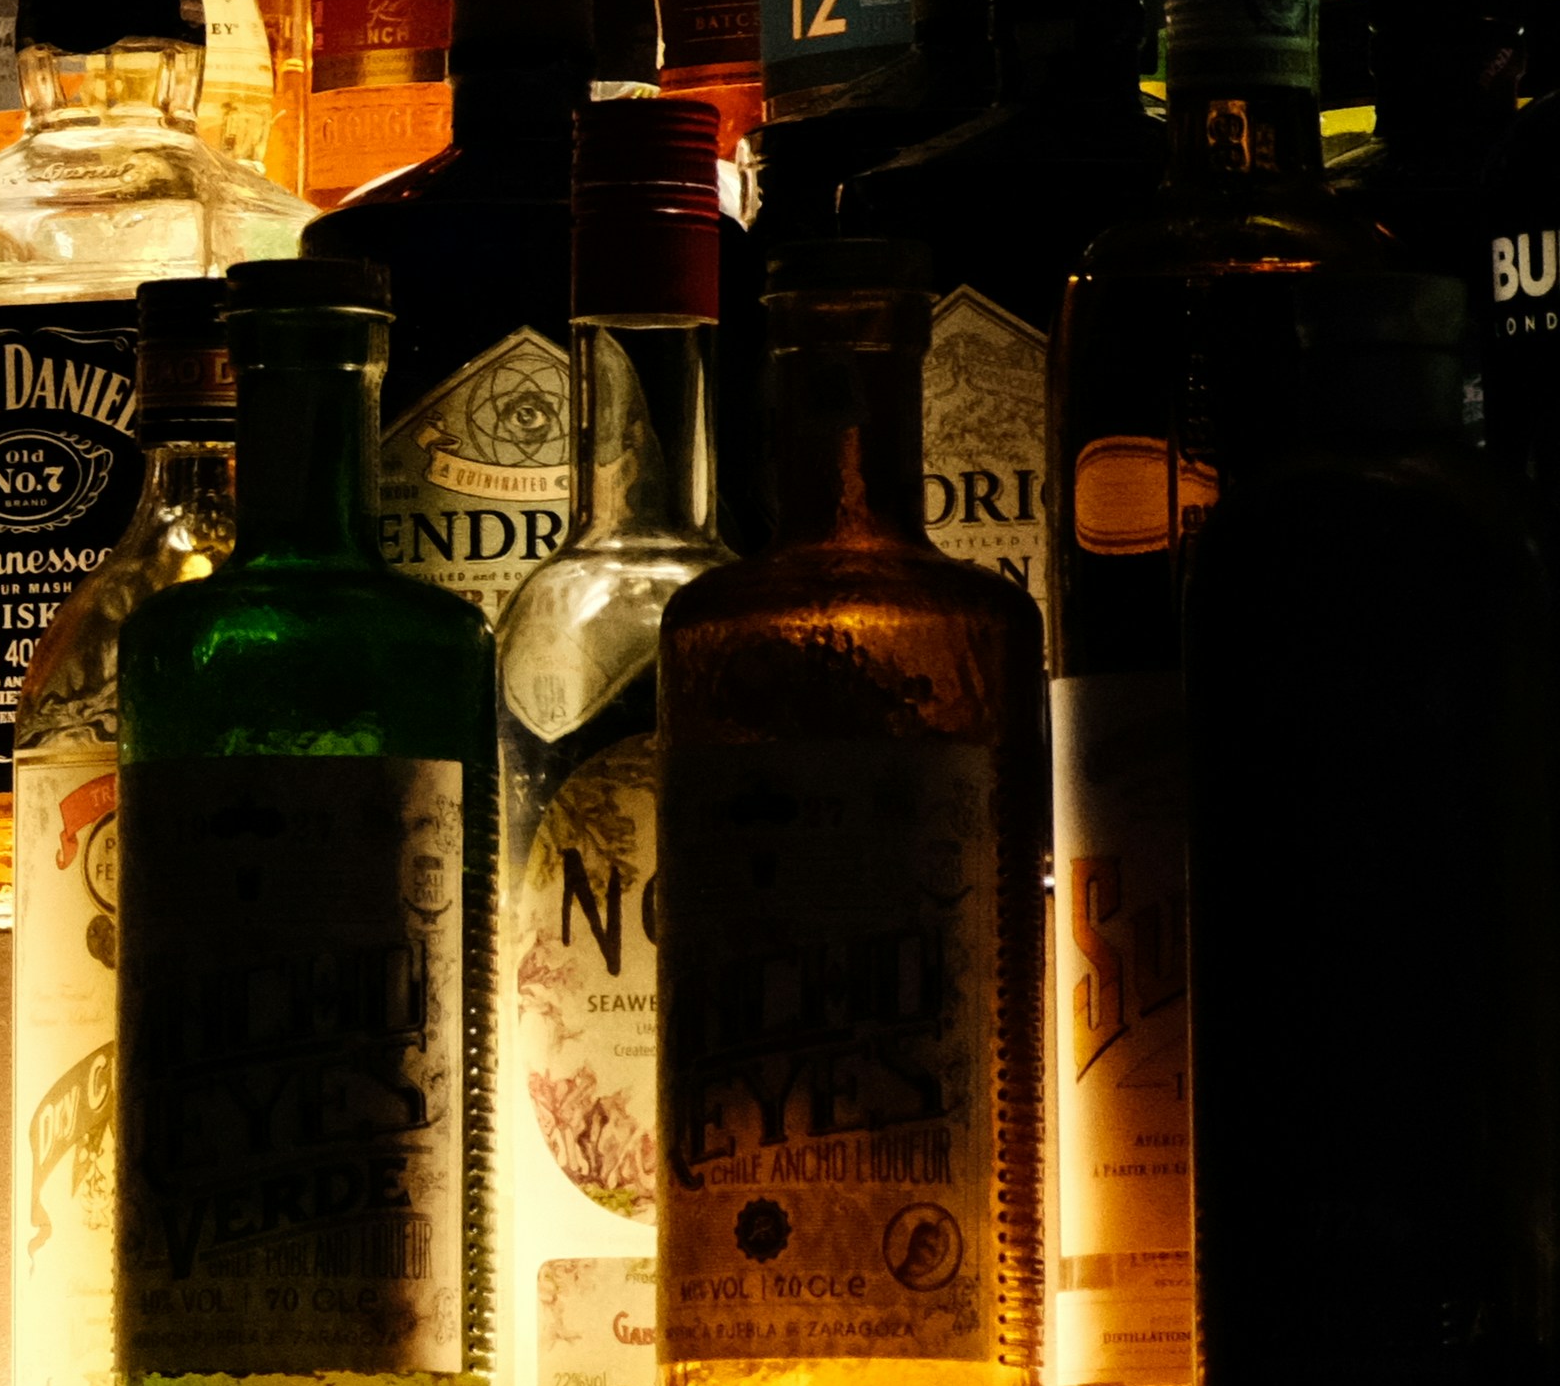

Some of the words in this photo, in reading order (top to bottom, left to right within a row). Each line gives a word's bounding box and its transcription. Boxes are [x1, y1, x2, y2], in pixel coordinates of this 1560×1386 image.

[1493, 229, 1560, 304] BU
[6, 449, 44, 463] Old
[5, 499, 47, 507] BRAND
[29, 582, 72, 594] MASH
[4, 676, 22, 688] AN
[39, 1086, 78, 1165] Dry
[711, 1149, 763, 1186] CHILE
[770, 1139, 847, 1184] ANCHO
[856, 1125, 952, 1184] LIQUEUR
[162, 1156, 412, 1279] VERDE
[361, 1221, 433, 1279] LIQUEUR
[774, 1276, 802, 1299] 70
[264, 1288, 299, 1311] 70
[807, 1320, 915, 1339] ZARAGOZA
